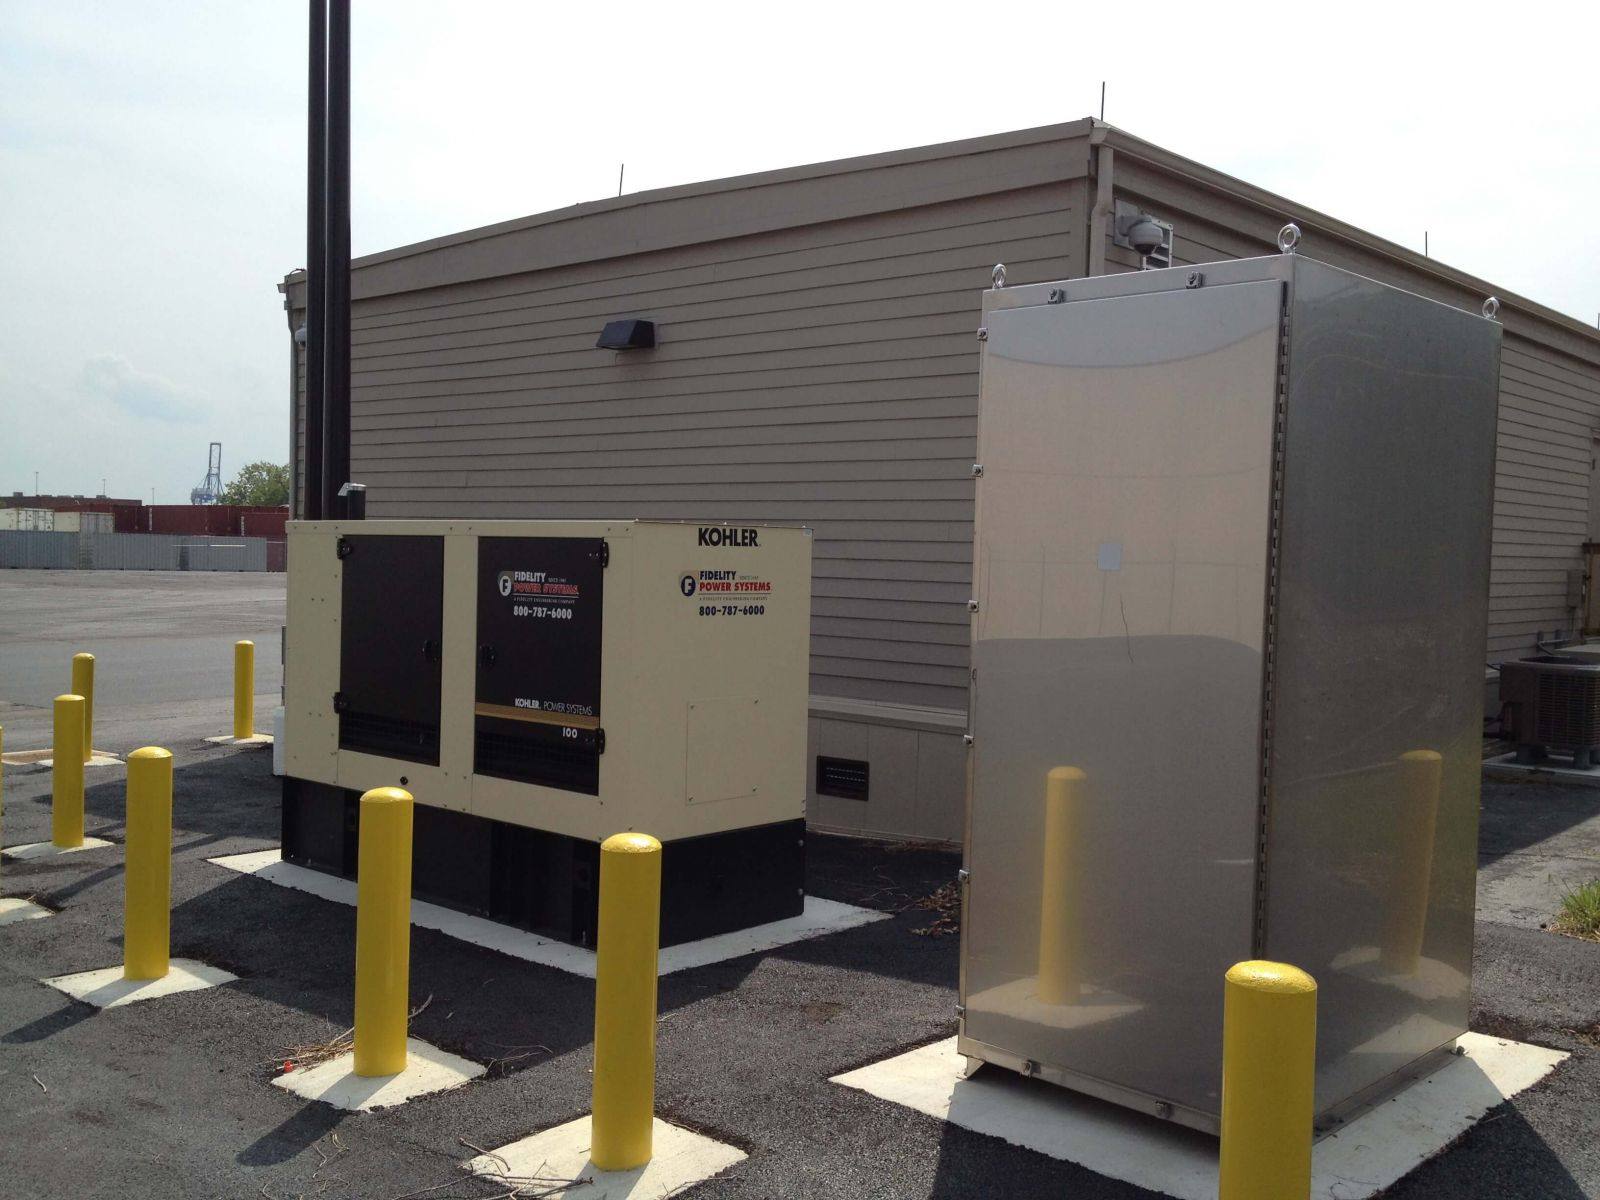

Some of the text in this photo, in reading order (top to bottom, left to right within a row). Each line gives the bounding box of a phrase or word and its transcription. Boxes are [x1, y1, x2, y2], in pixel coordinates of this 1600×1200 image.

[698, 527, 759, 547] KOHLER
[514, 571, 546, 583] FIDELITY
[700, 570, 736, 581] FIDELITY
[513, 582, 579, 595] POWER SYSTEMS
[699, 582, 771, 592] POWER SYSTEMS
[513, 605, 572, 620] 800-787-6000
[699, 605, 764, 616] 800-787-6000
[514, 697, 593, 716] KOHLER POWER SYSTEMS
[562, 727, 578, 739] 100
